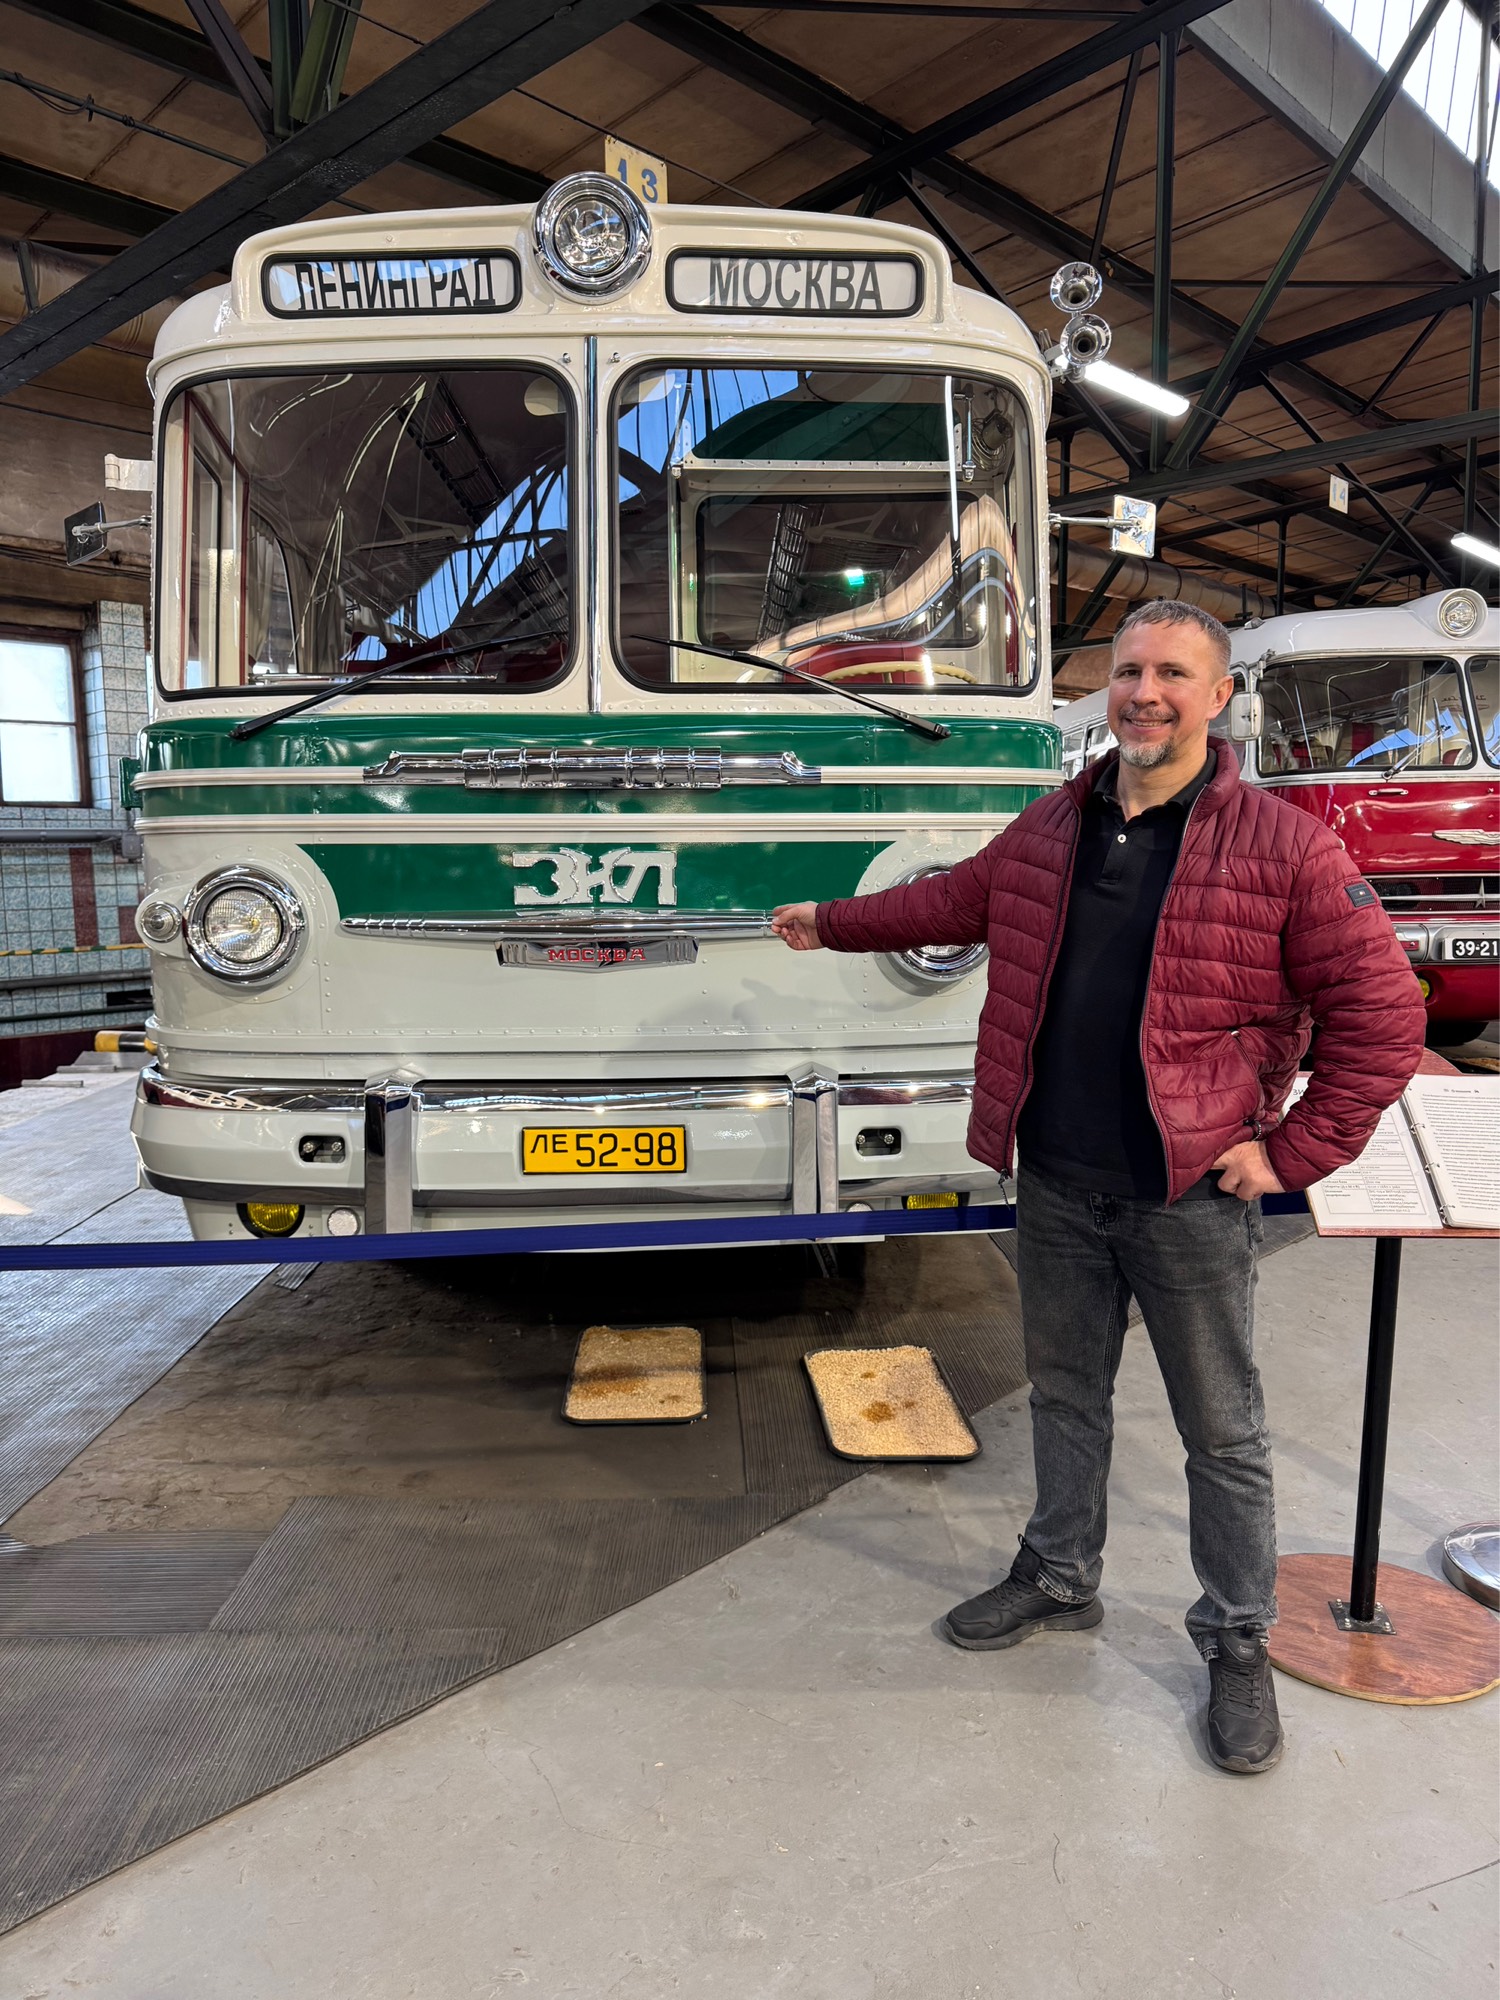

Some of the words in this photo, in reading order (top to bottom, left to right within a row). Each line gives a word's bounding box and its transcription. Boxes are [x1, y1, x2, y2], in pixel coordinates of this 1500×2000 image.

[617, 158, 658, 203] 13
[295, 257, 496, 310] ЛЕНИНГРАД
[709, 257, 883, 310] МОСКВА
[548, 947, 646, 962] МОСКВА
[1455, 940, 1498, 956] 39-21
[530, 1134, 568, 1153] ЛЕ
[576, 1132, 676, 1167] 52-98
